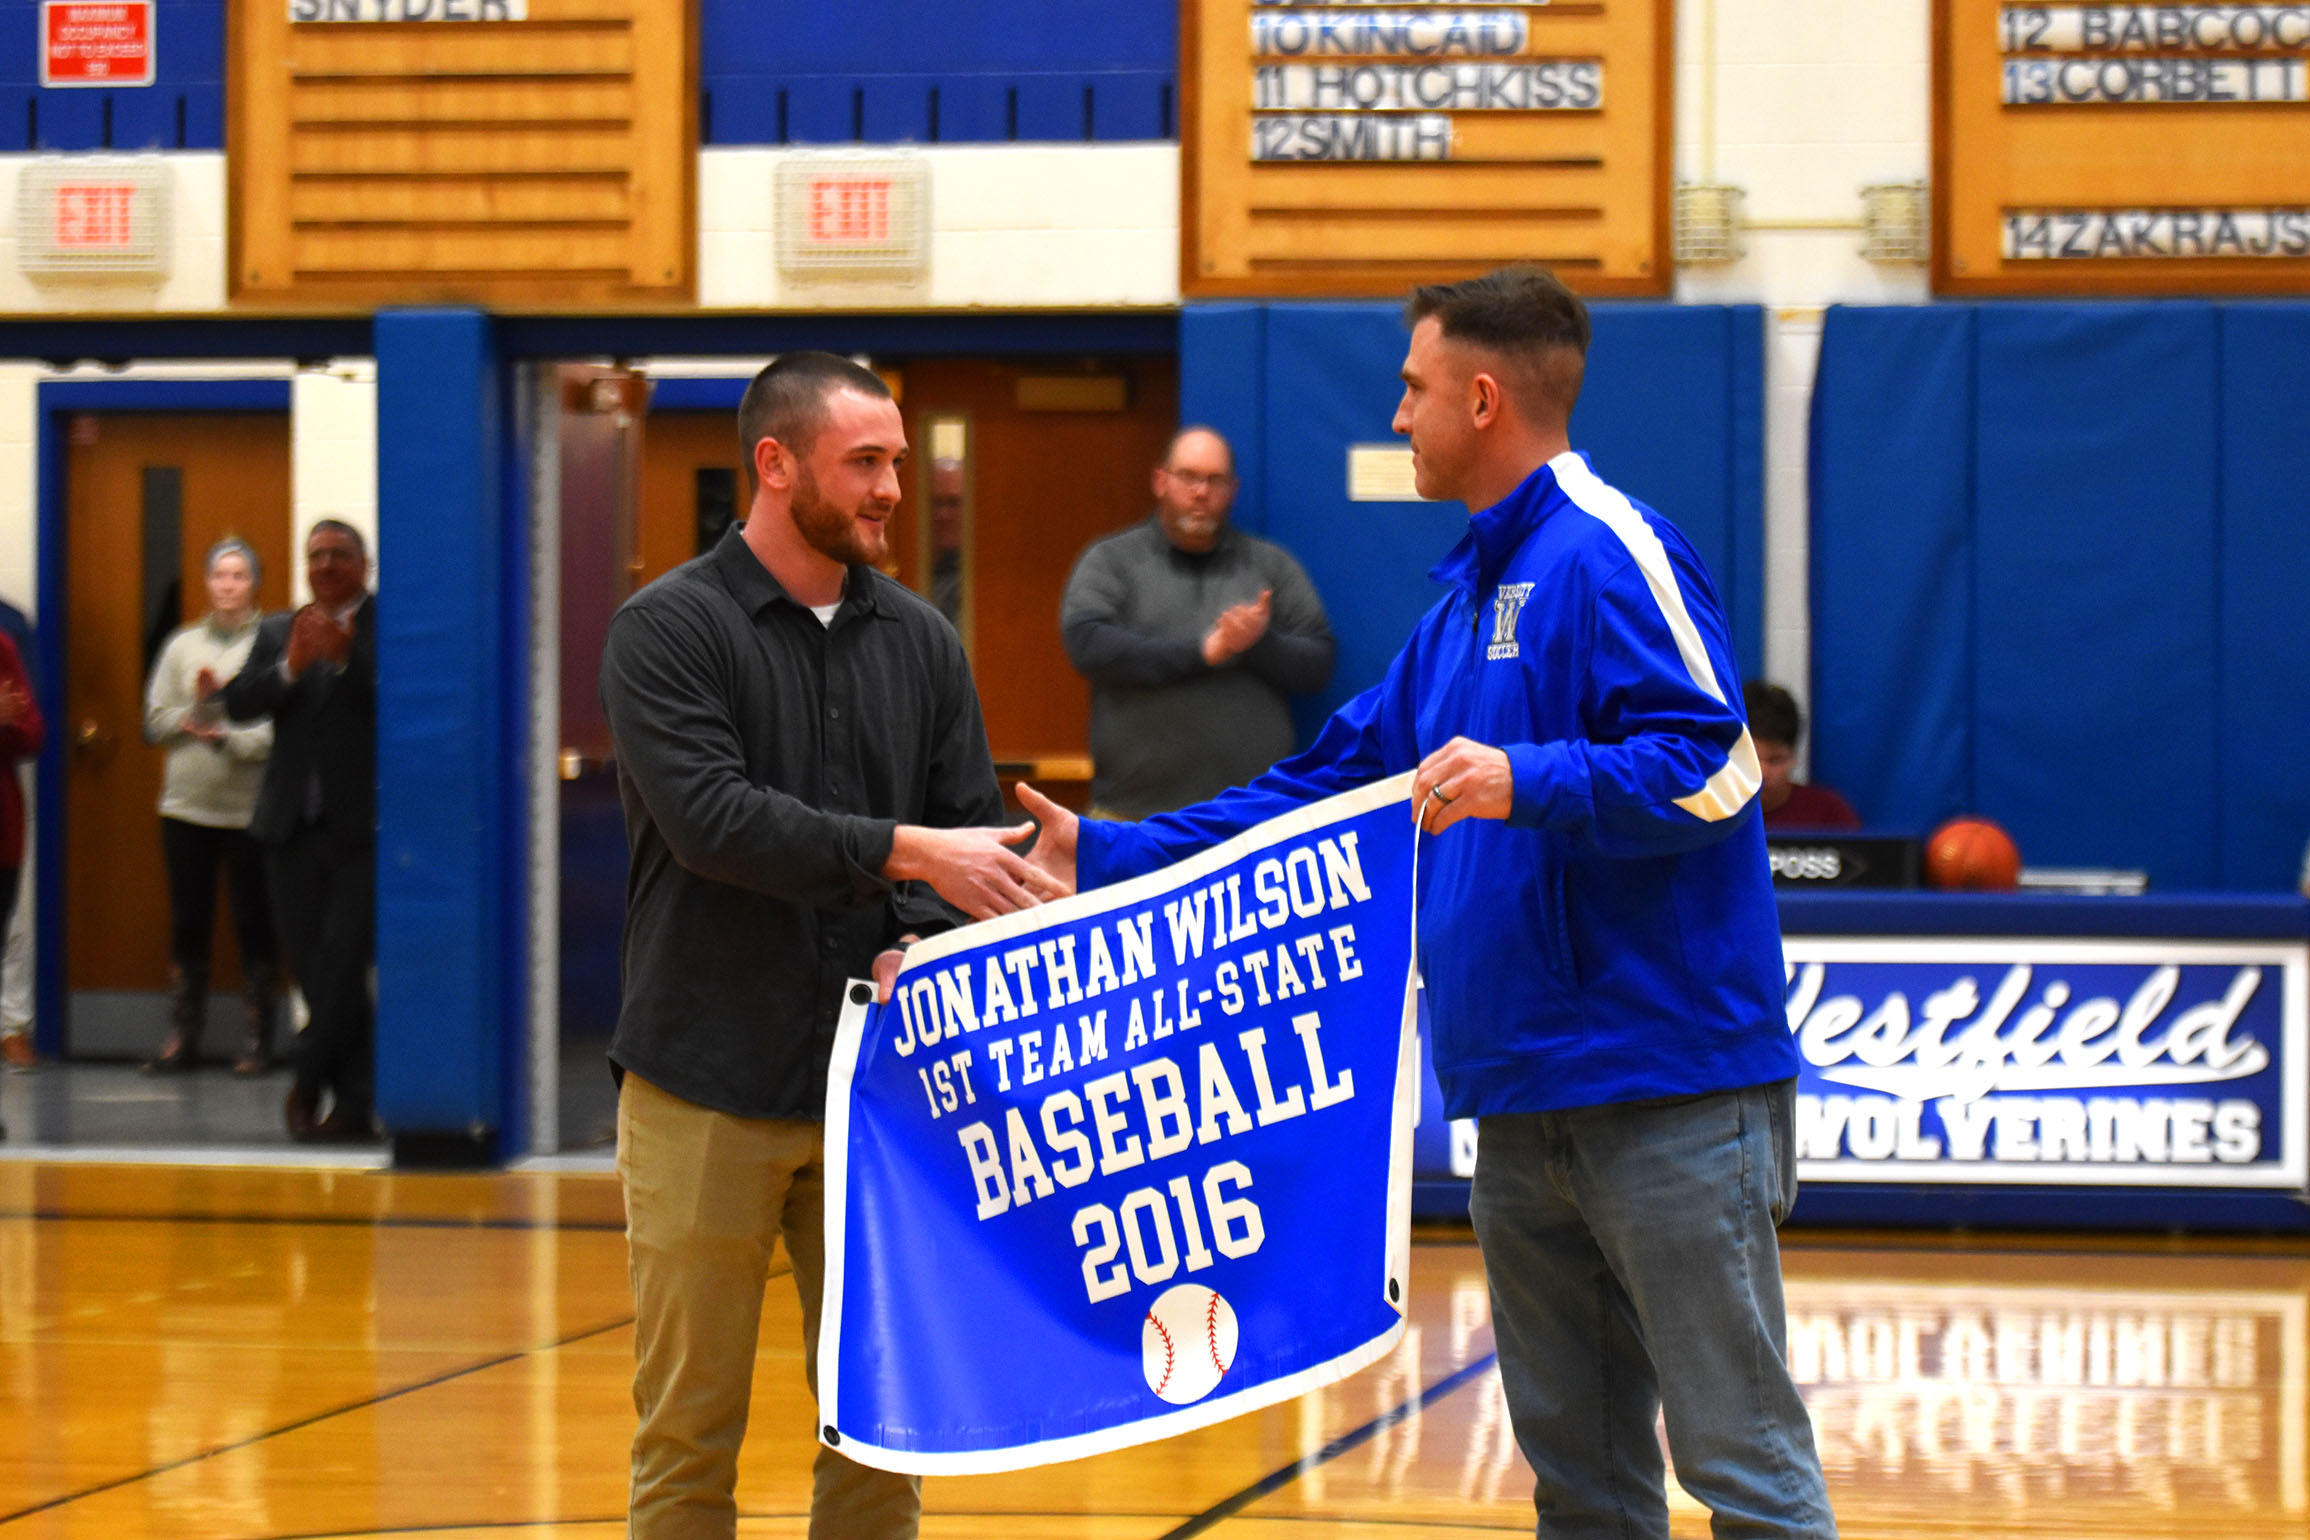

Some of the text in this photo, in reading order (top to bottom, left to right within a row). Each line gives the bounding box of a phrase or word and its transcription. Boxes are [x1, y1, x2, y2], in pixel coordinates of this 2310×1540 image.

[2005, 9, 2049, 50] 12
[1255, 64, 1600, 108] 11 HOTCHKISS
[55, 182, 136, 248] EXIT
[811, 175, 892, 244] EXIT
[893, 830, 1372, 1057] JONATHAN WILSON
[918, 924, 1363, 1119] 1ST TEAM ALL-STATE
[957, 1011, 1355, 1221] BASEBALL
[1797, 1095, 2261, 1165] WOLVERINES
[1071, 1160, 1267, 1304] 2016
